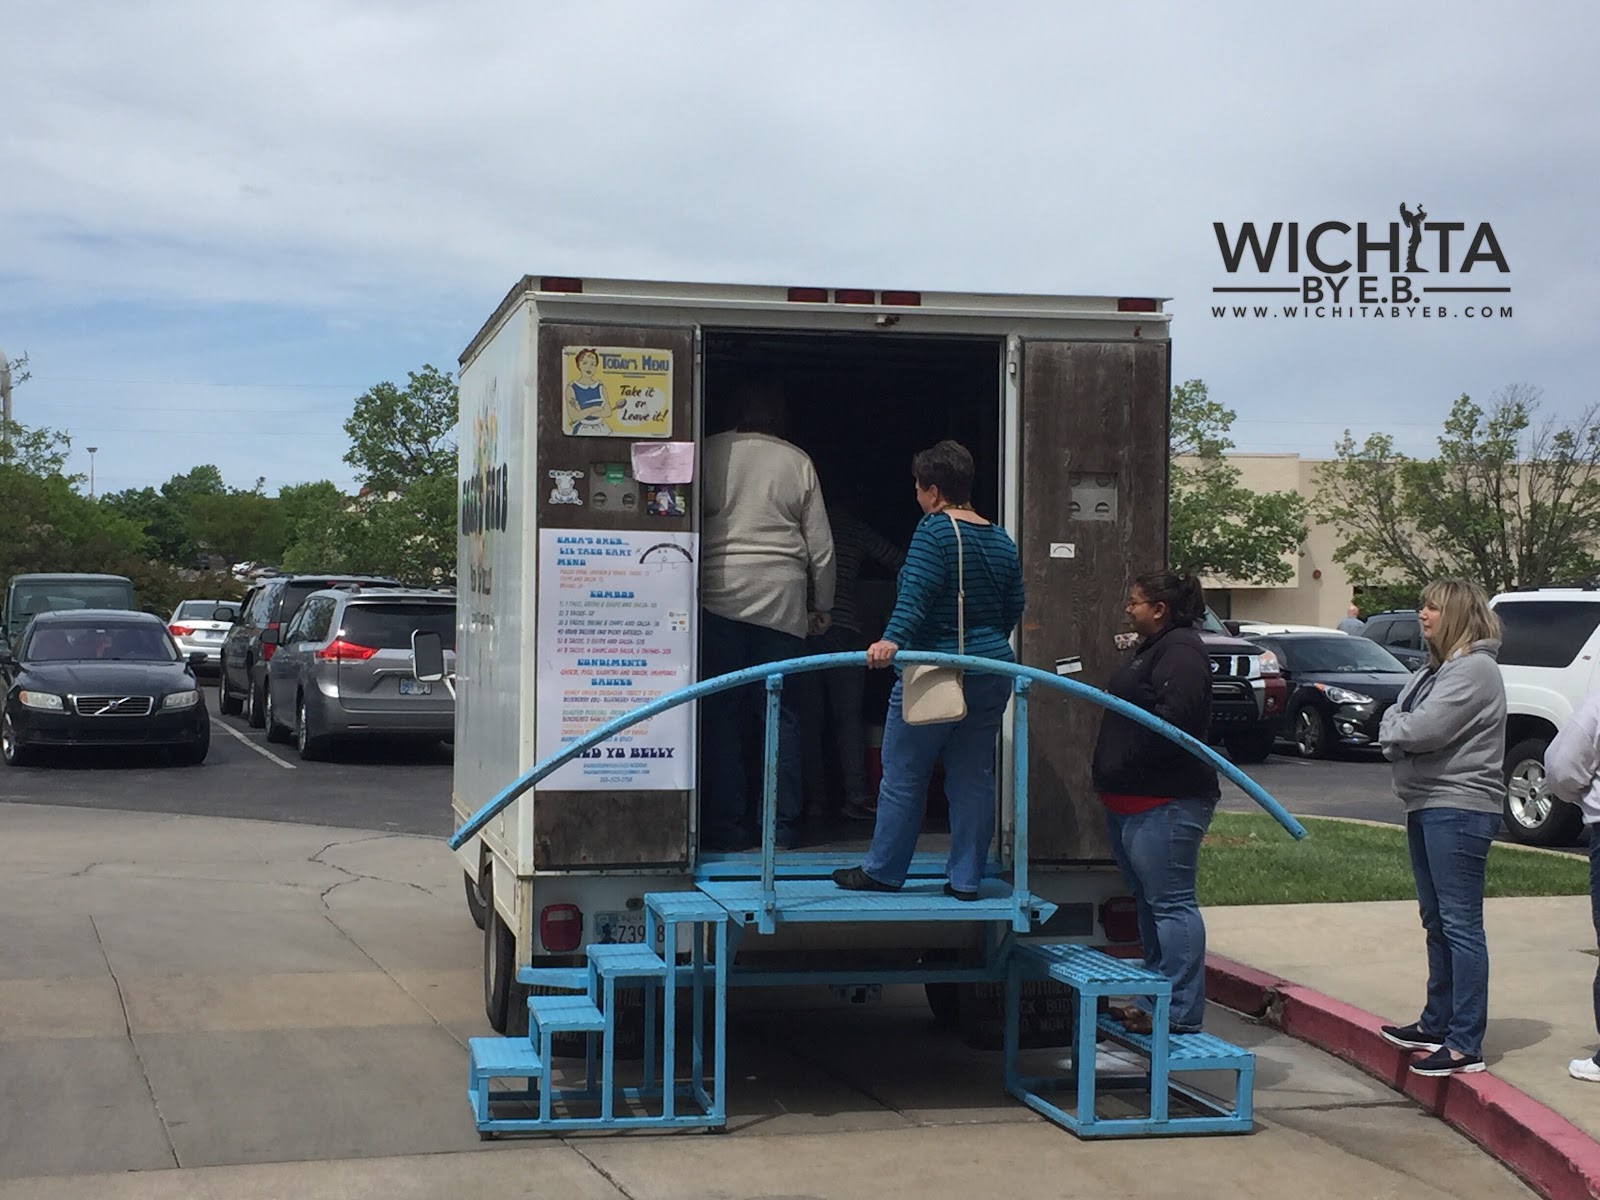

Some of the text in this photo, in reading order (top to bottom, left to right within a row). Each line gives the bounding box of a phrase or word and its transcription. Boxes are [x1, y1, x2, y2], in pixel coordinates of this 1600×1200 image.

[620, 385, 655, 397] Take it
[634, 400, 646, 408] or
[622, 409, 668, 422] Leave it!
[577, 659, 648, 667] CONDIMENTS
[591, 678, 632, 686] SAUCES
[606, 748, 626, 758] YO
[629, 748, 675, 758] BELLY
[618, 925, 665, 943] Z398
